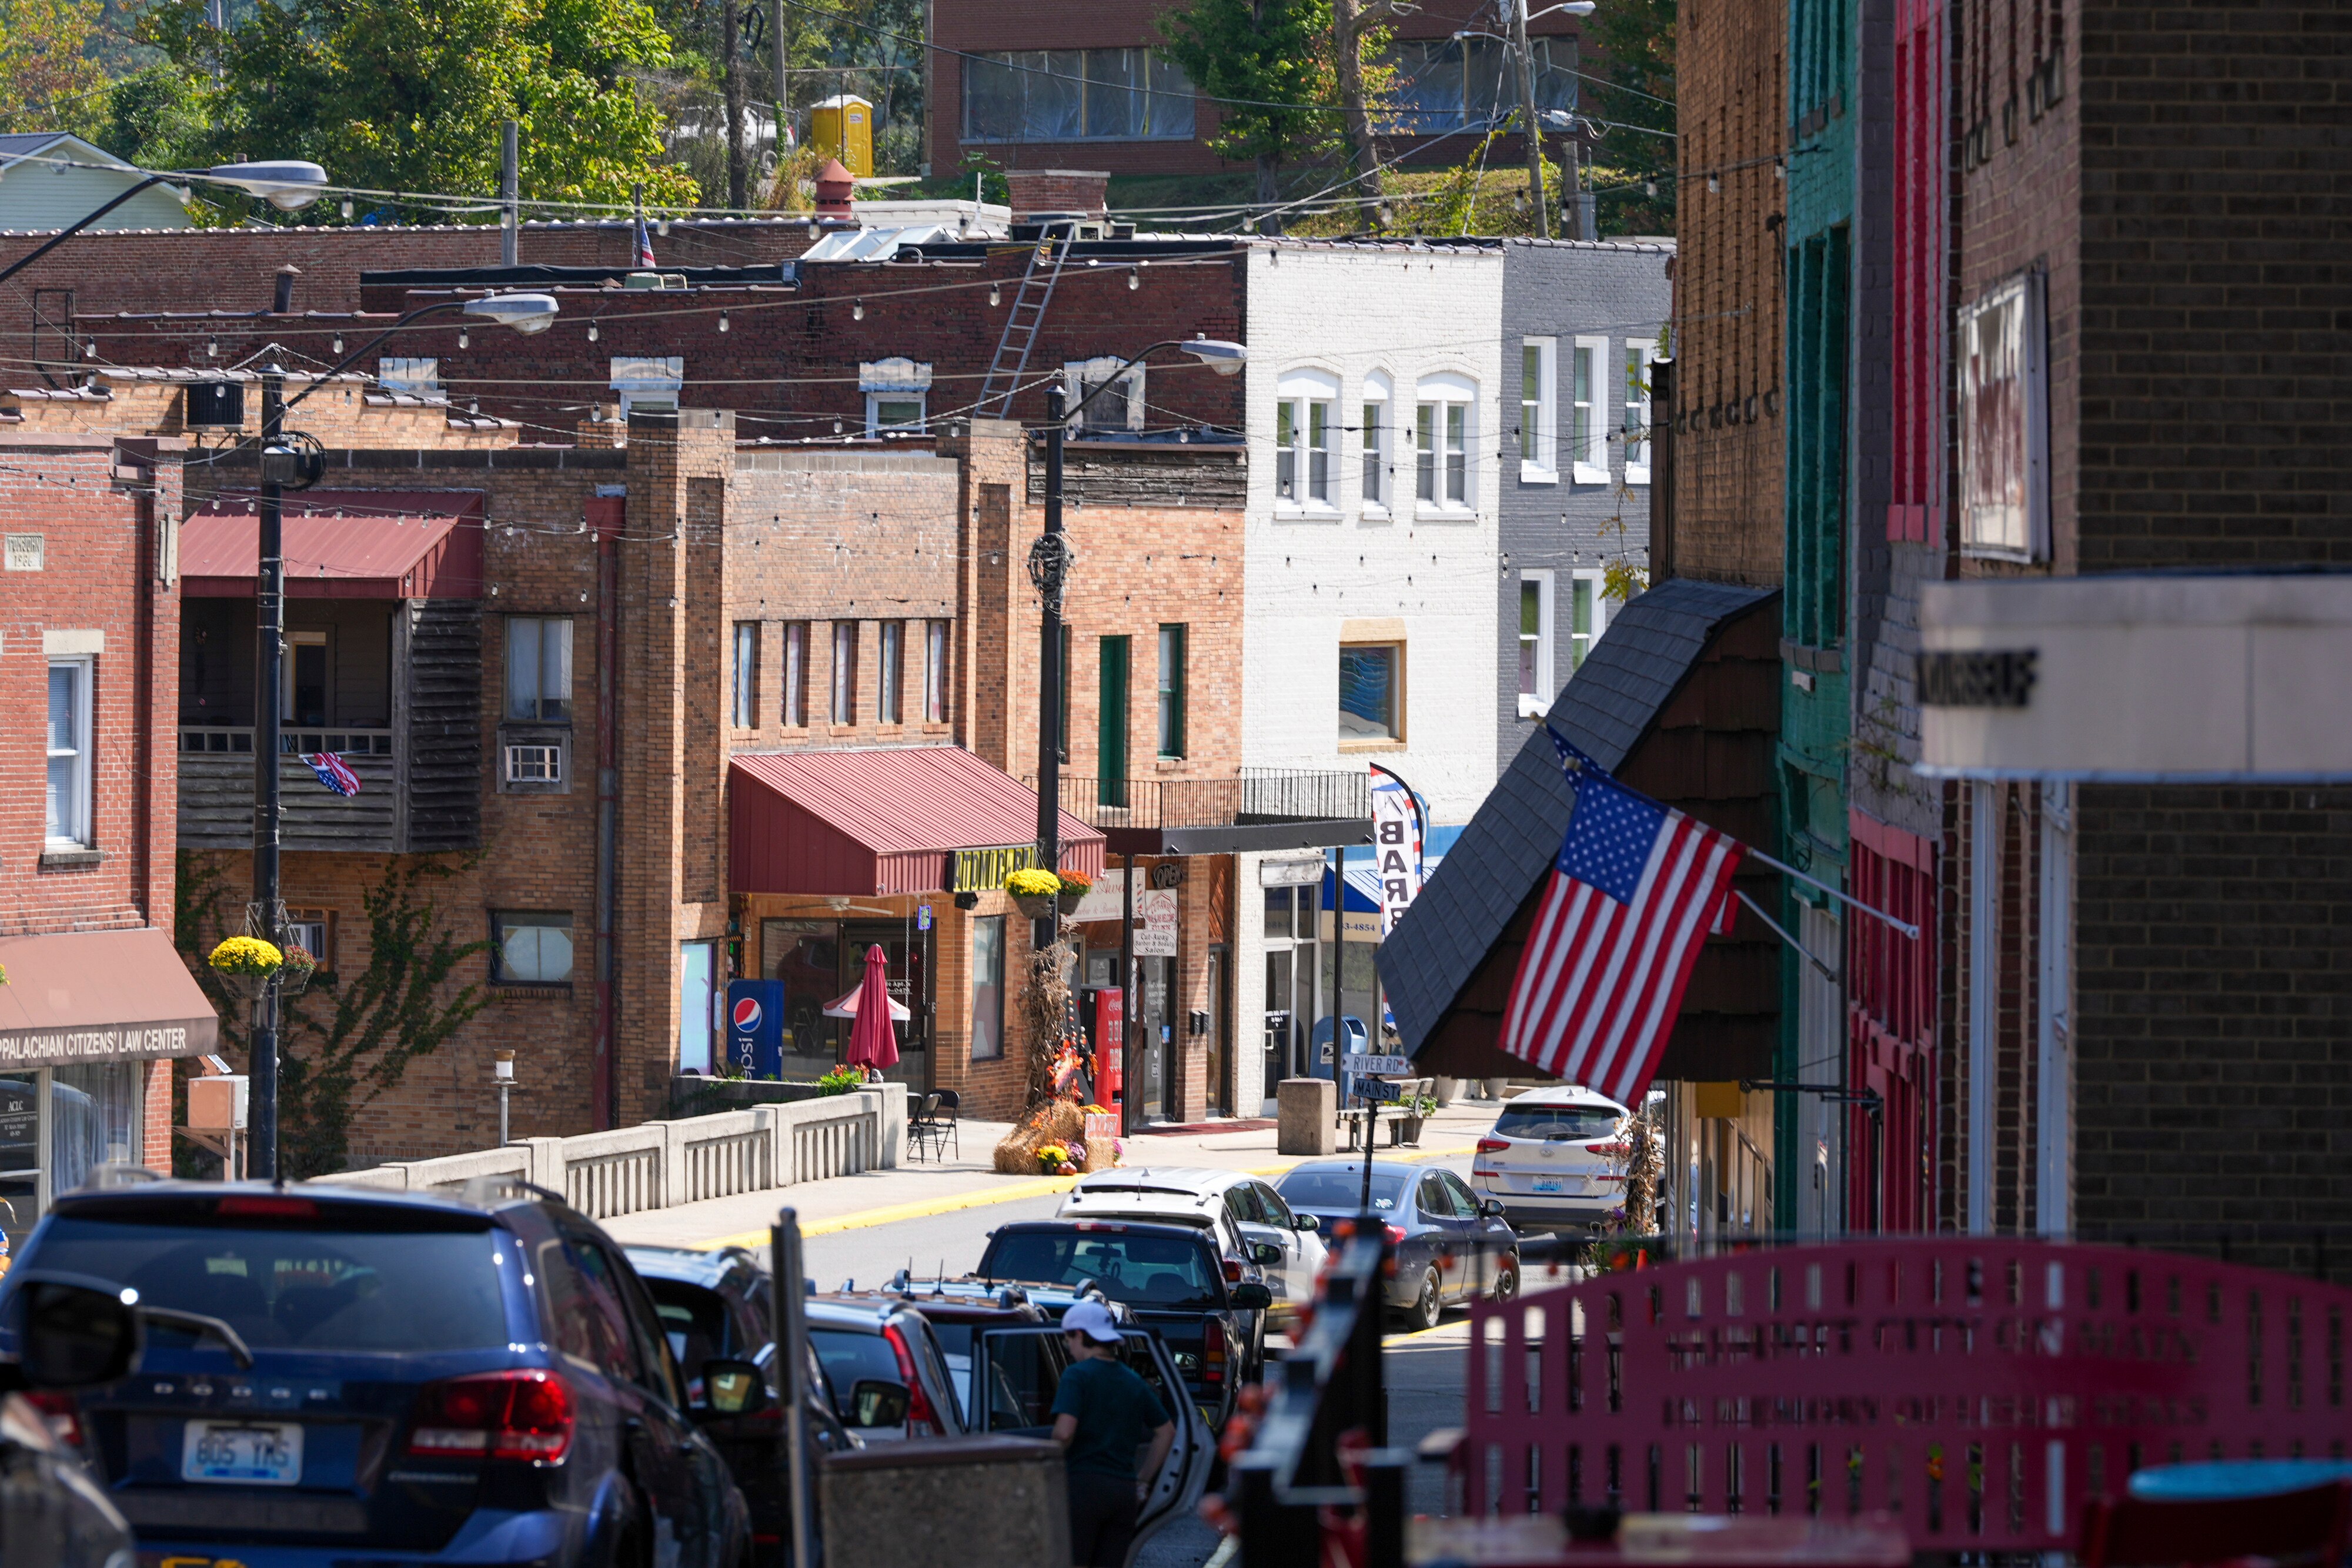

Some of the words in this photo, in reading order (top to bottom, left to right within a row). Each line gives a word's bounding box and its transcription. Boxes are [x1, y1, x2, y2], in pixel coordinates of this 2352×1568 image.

[953, 851, 1006, 888] ATOMIC
[1156, 866, 1182, 889] OPEN
[66, 1031, 117, 1056] CITIZENS'
[118, 1029, 142, 1053] LAW
[143, 1027, 186, 1051] CENTER
[1354, 1056, 1382, 1072] RIVER
[1357, 1081, 1381, 1098] MAIN
[1871, 1314, 1982, 1355] CITY
[1994, 1316, 2067, 1356] ON
[2079, 1321, 2201, 1368] MAIN
[153, 1383, 328, 1400] DODGE
